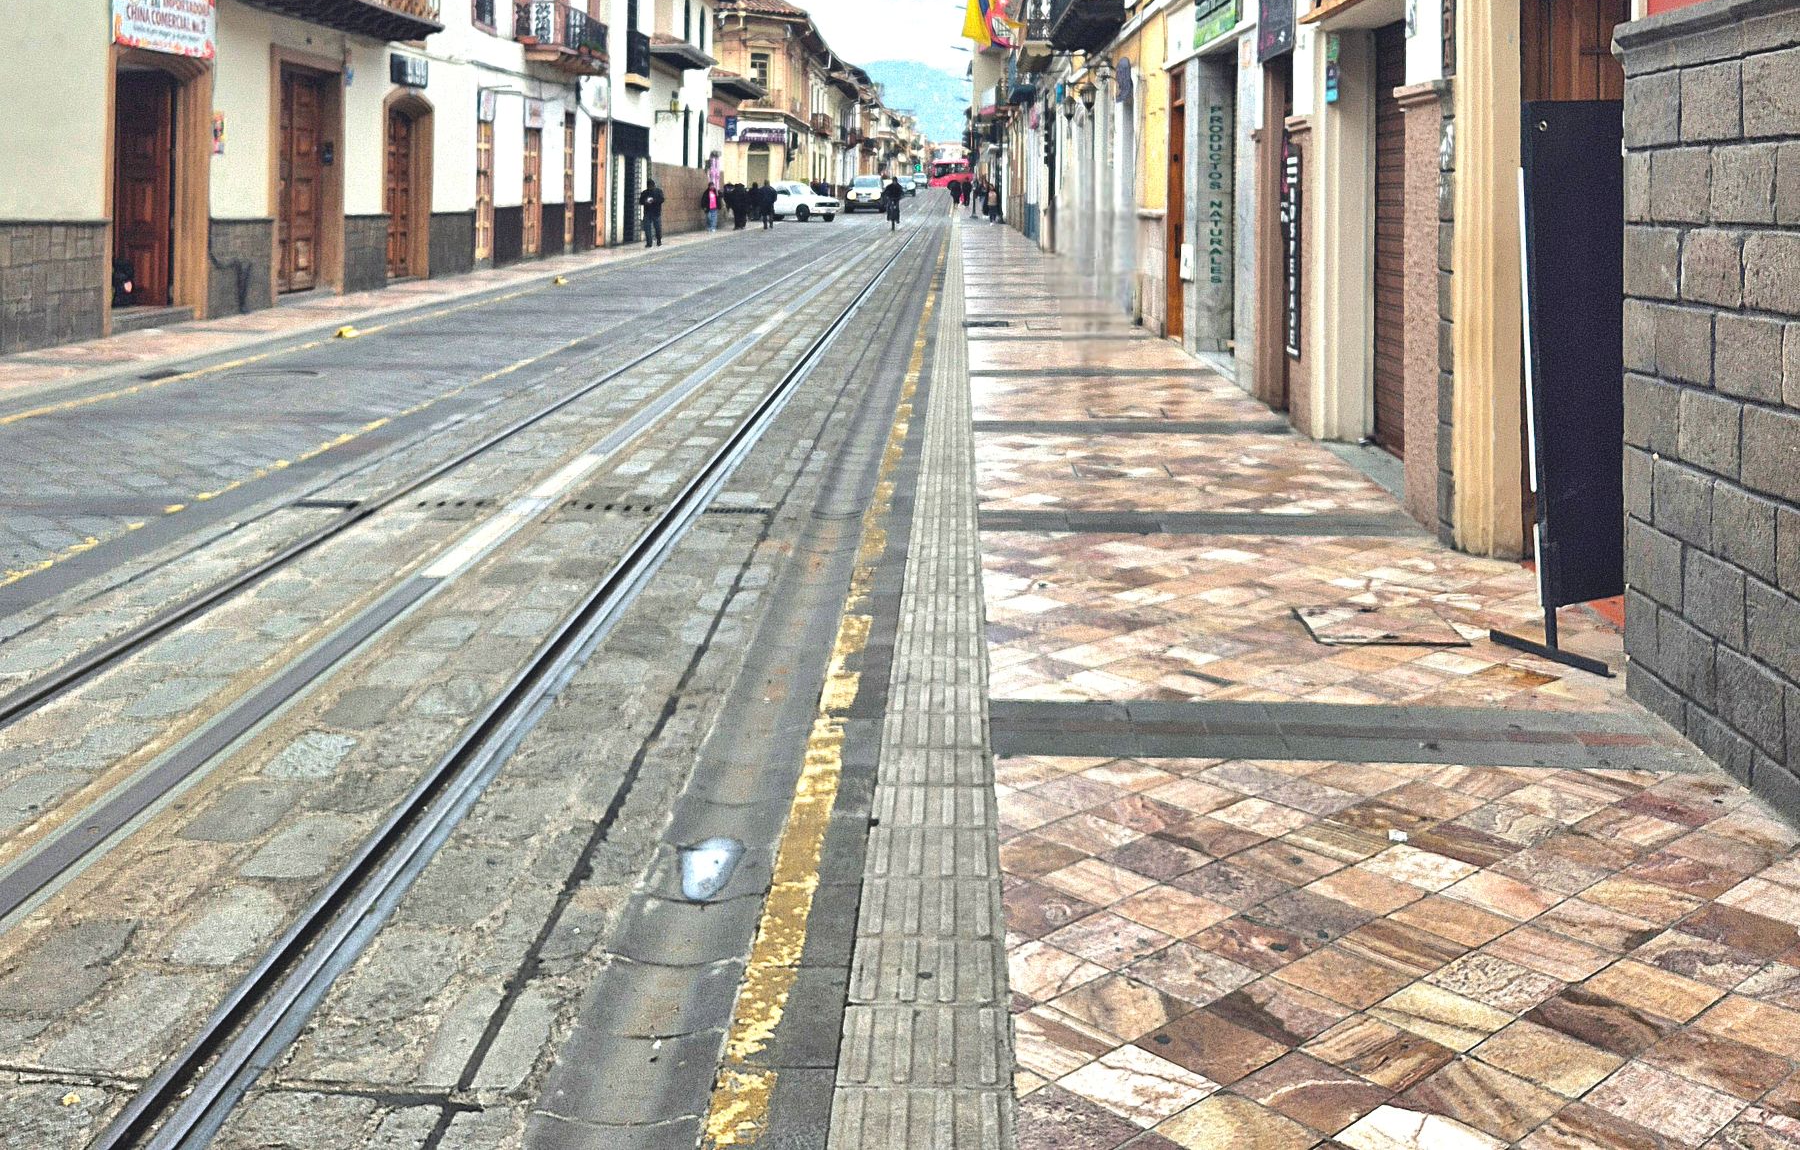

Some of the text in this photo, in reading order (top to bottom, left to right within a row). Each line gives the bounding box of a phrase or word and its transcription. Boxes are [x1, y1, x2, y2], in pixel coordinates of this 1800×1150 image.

[126, 3, 150, 24] CHINA
[1208, 106, 1223, 284] PRODUCTOS NATURALES
